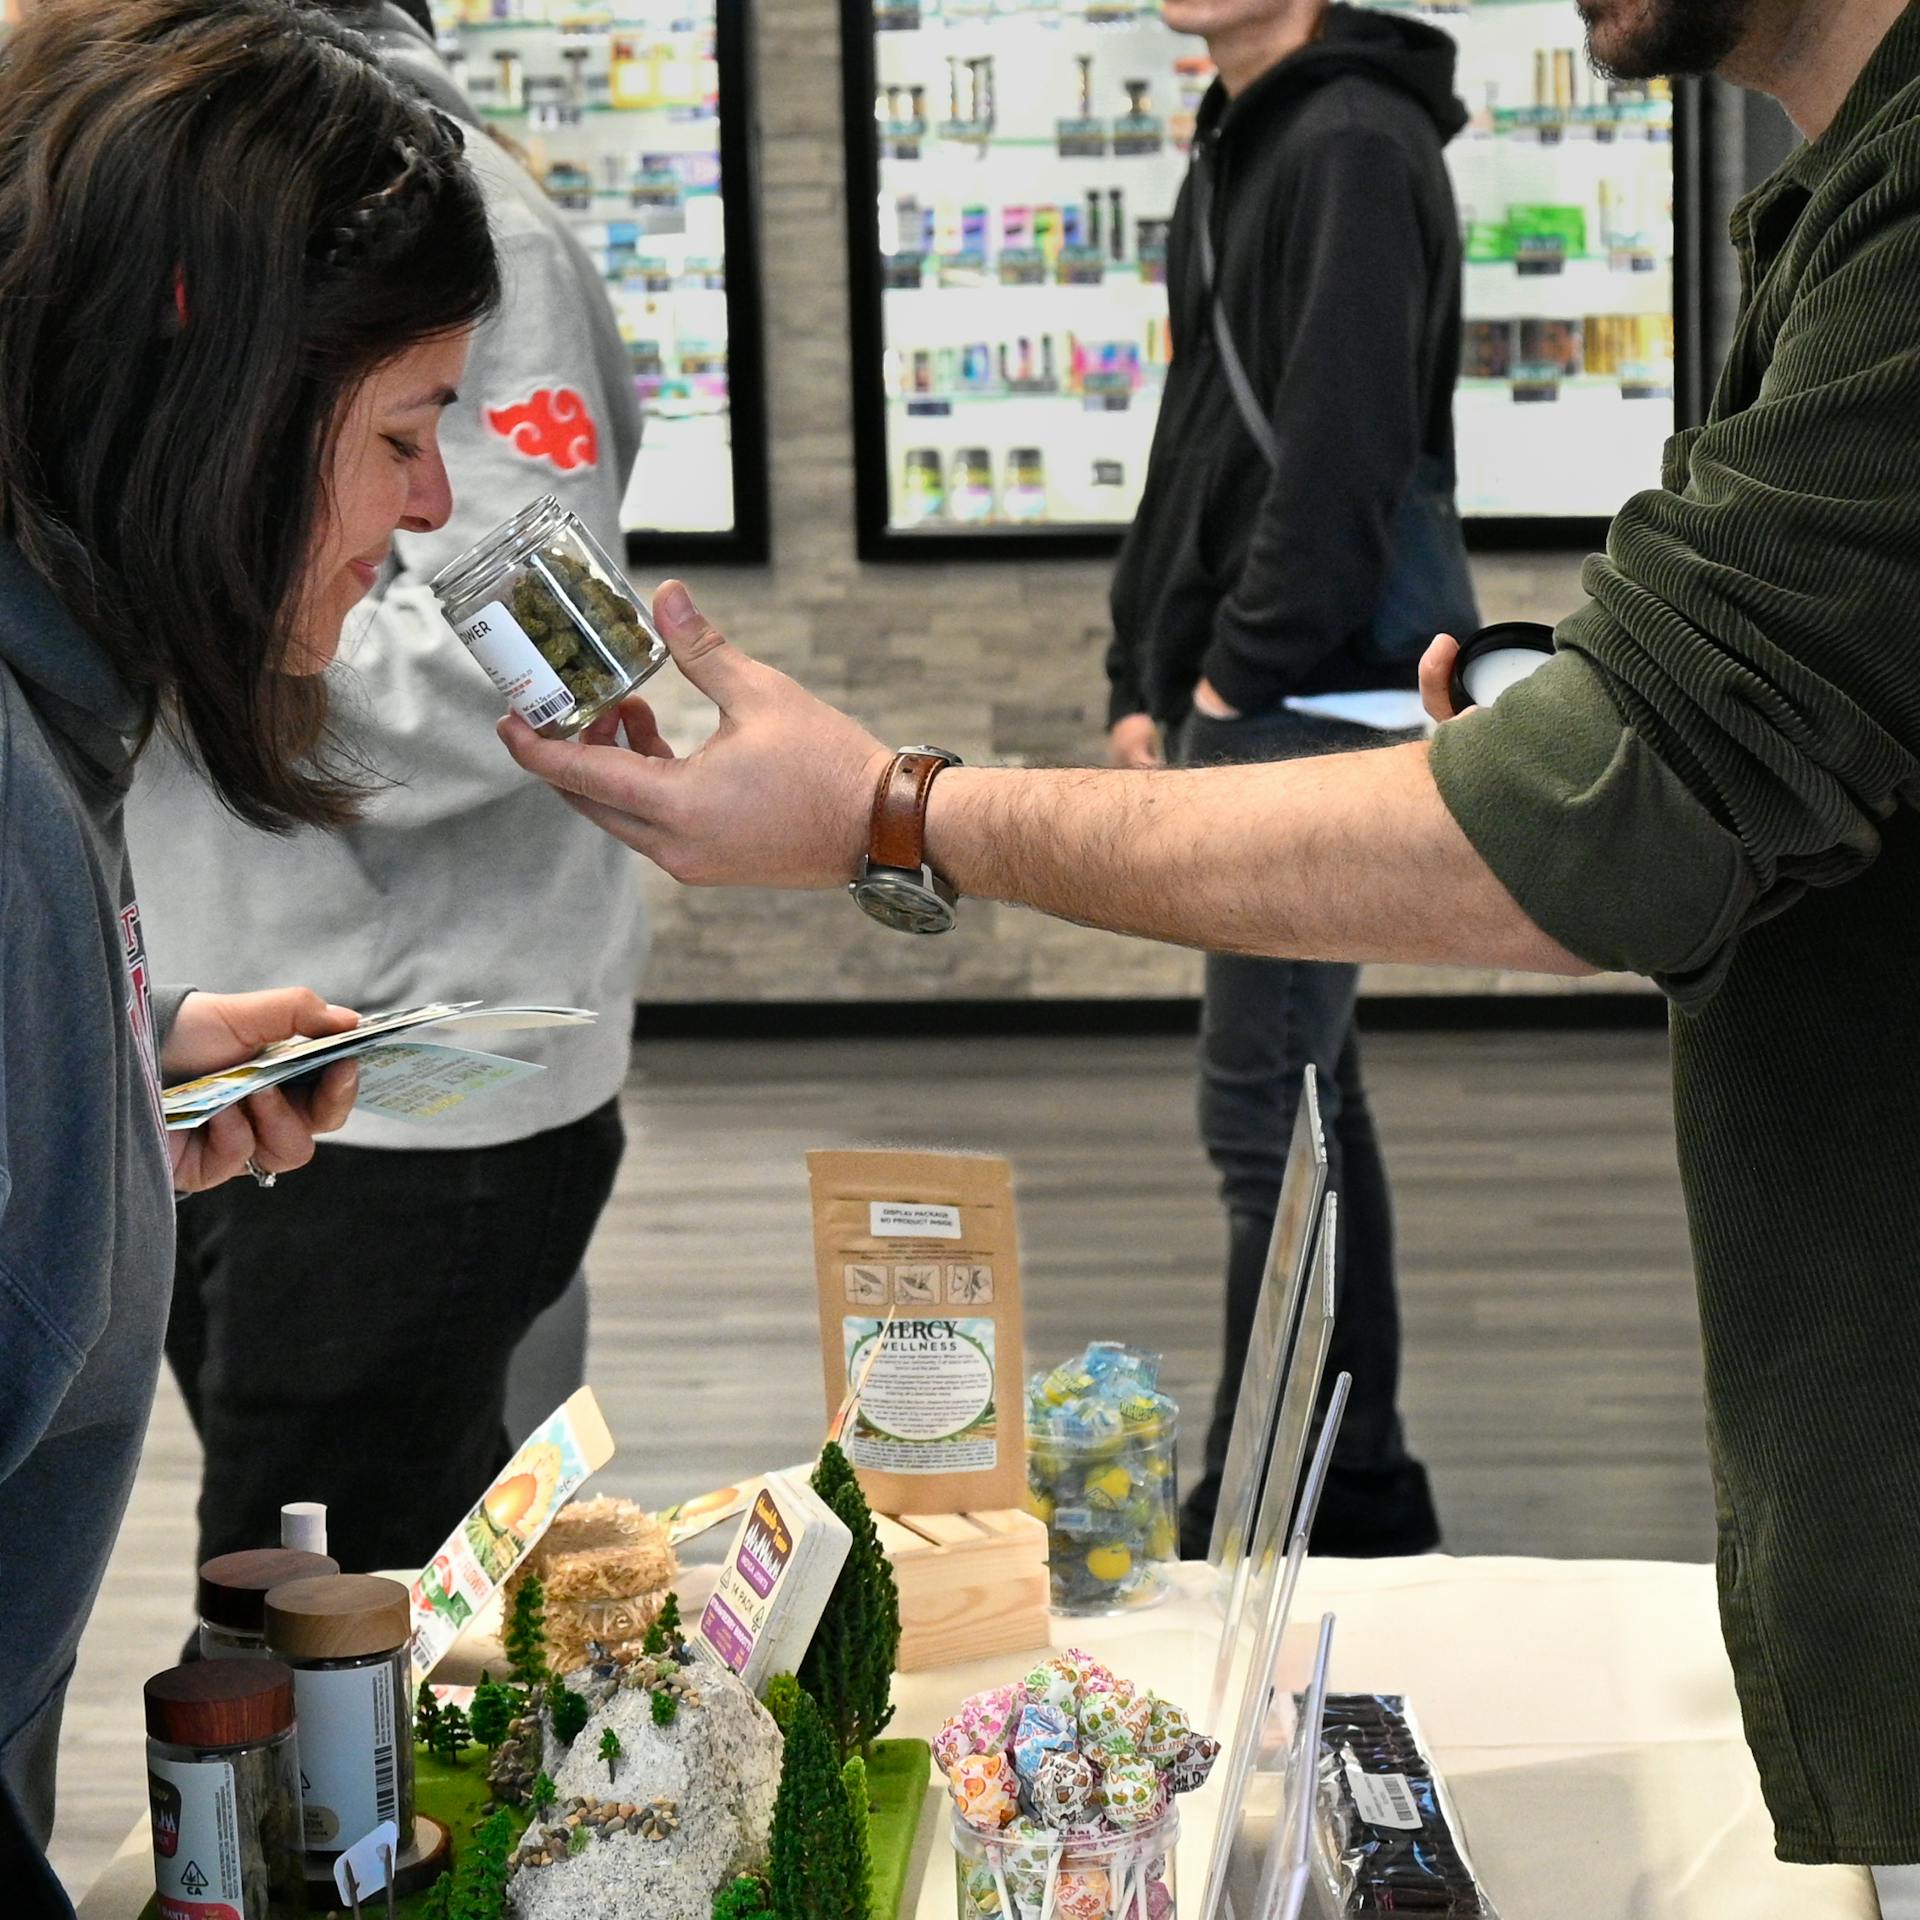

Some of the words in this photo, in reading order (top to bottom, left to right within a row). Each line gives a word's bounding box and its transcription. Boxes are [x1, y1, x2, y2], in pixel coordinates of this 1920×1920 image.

[883, 1208, 912, 1217] DISPLAY
[914, 1211, 949, 1219] PACKAGE
[893, 1218, 928, 1226] PRODUCT
[876, 1320, 958, 1341] MERCY
[739, 1590, 754, 1613] PACK
[187, 1886, 203, 1896] CA
